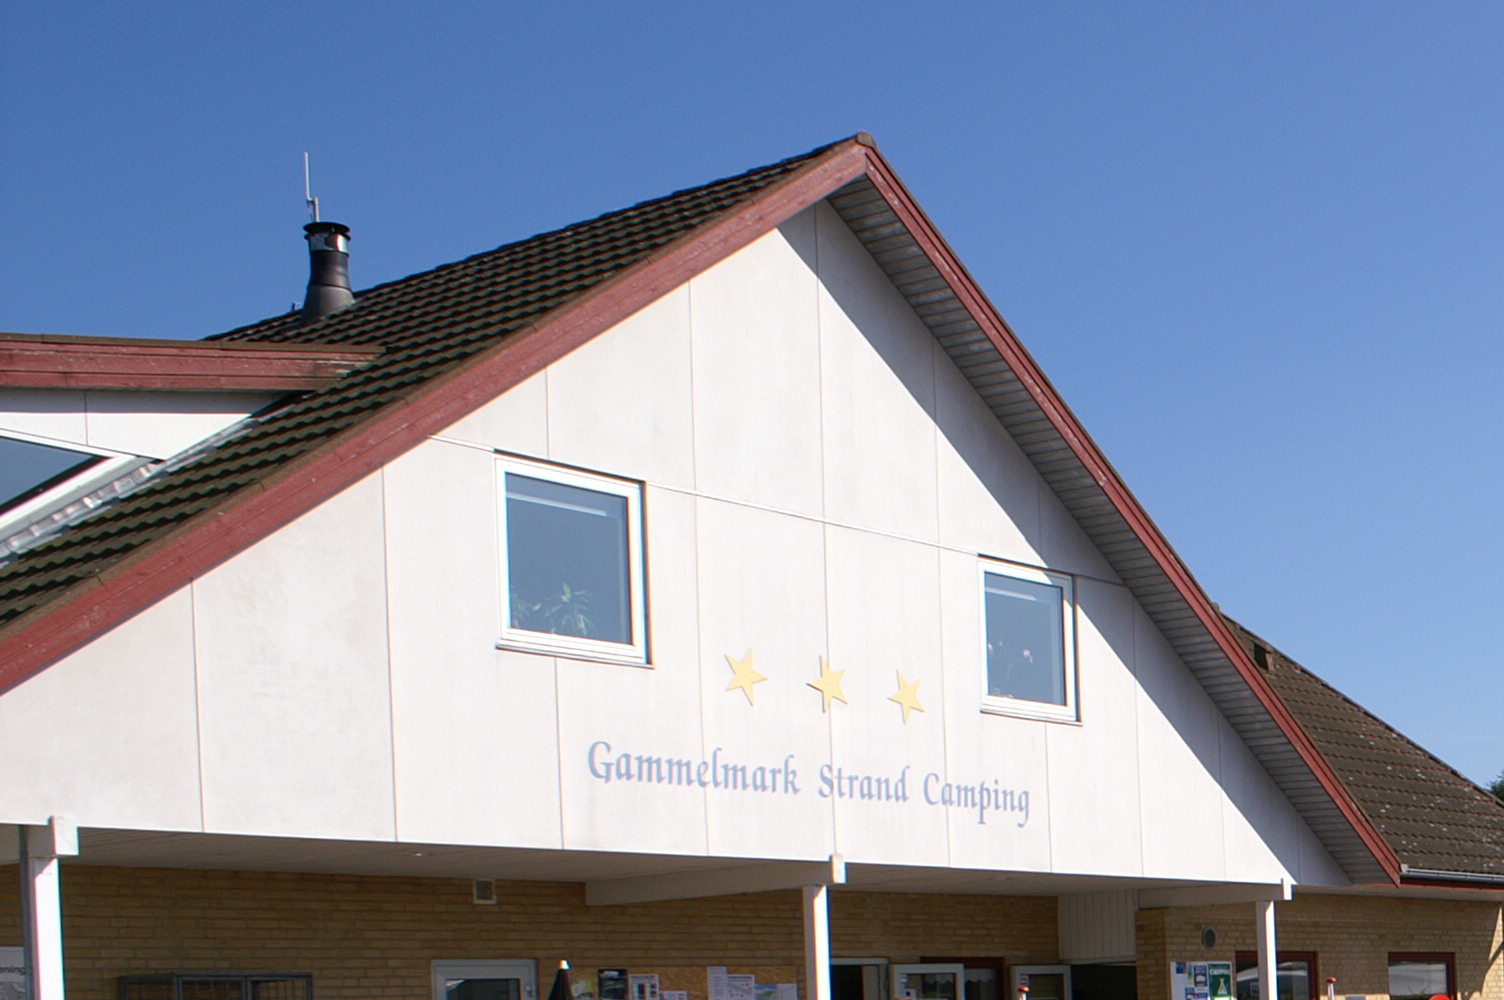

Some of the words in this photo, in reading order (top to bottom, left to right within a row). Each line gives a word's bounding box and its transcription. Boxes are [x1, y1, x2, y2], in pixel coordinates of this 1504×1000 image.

[587, 740, 801, 796] Gammelmark
[818, 763, 911, 803] Strand
[923, 772, 1030, 828] Camping
